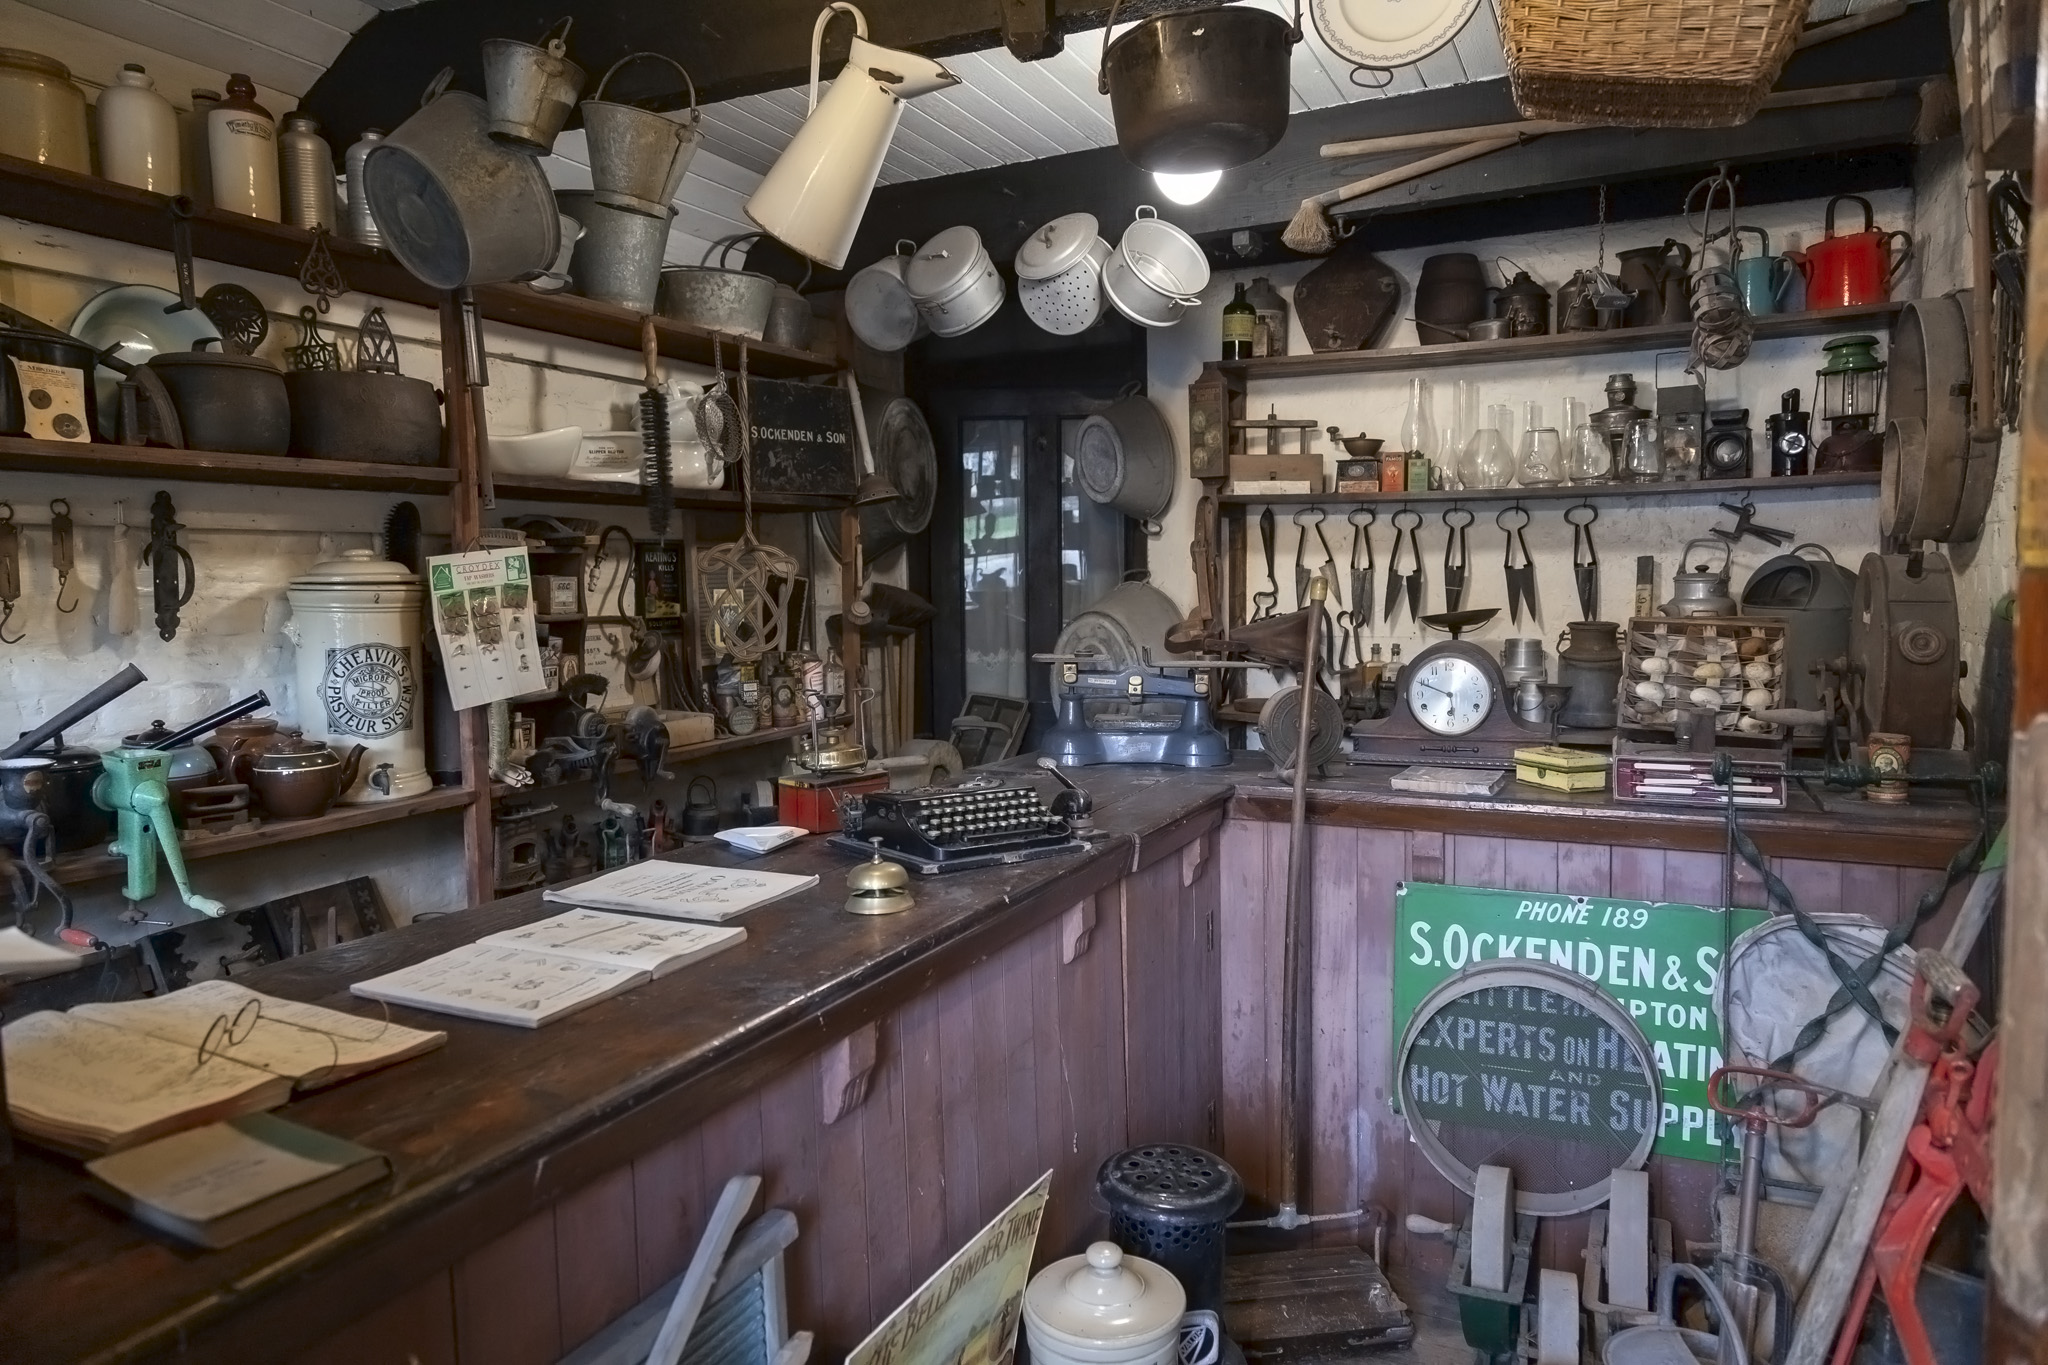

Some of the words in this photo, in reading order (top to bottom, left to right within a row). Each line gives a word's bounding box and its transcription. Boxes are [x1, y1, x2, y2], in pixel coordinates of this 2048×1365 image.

[816, 434, 823, 443] &
[826, 431, 846, 444] SON
[645, 551, 677, 563] KEATING'S
[456, 562, 501, 573] CROYDEX
[658, 564, 675, 572] KILLS
[332, 648, 408, 679] CHEAVIN'S
[352, 674, 391, 685] MICROBE
[360, 689, 385, 697] PROOF
[327, 686, 378, 733] PASTEUR
[381, 685, 412, 730] SYSTEM
[354, 700, 391, 709] FILTER
[1515, 900, 1594, 925] PHONE
[1602, 906, 1649, 930] 189
[1661, 954, 1689, 993] &
[1563, 1036, 1590, 1067] ON
[1548, 1070, 1601, 1087] AND
[1411, 1064, 1469, 1108] HOT
[1480, 1073, 1591, 1127] WATER
[1609, 1089, 1742, 1149] SUPPL
[947, 1230, 1005, 1303] BINDER
[1003, 1207, 1042, 1251] TWINE
